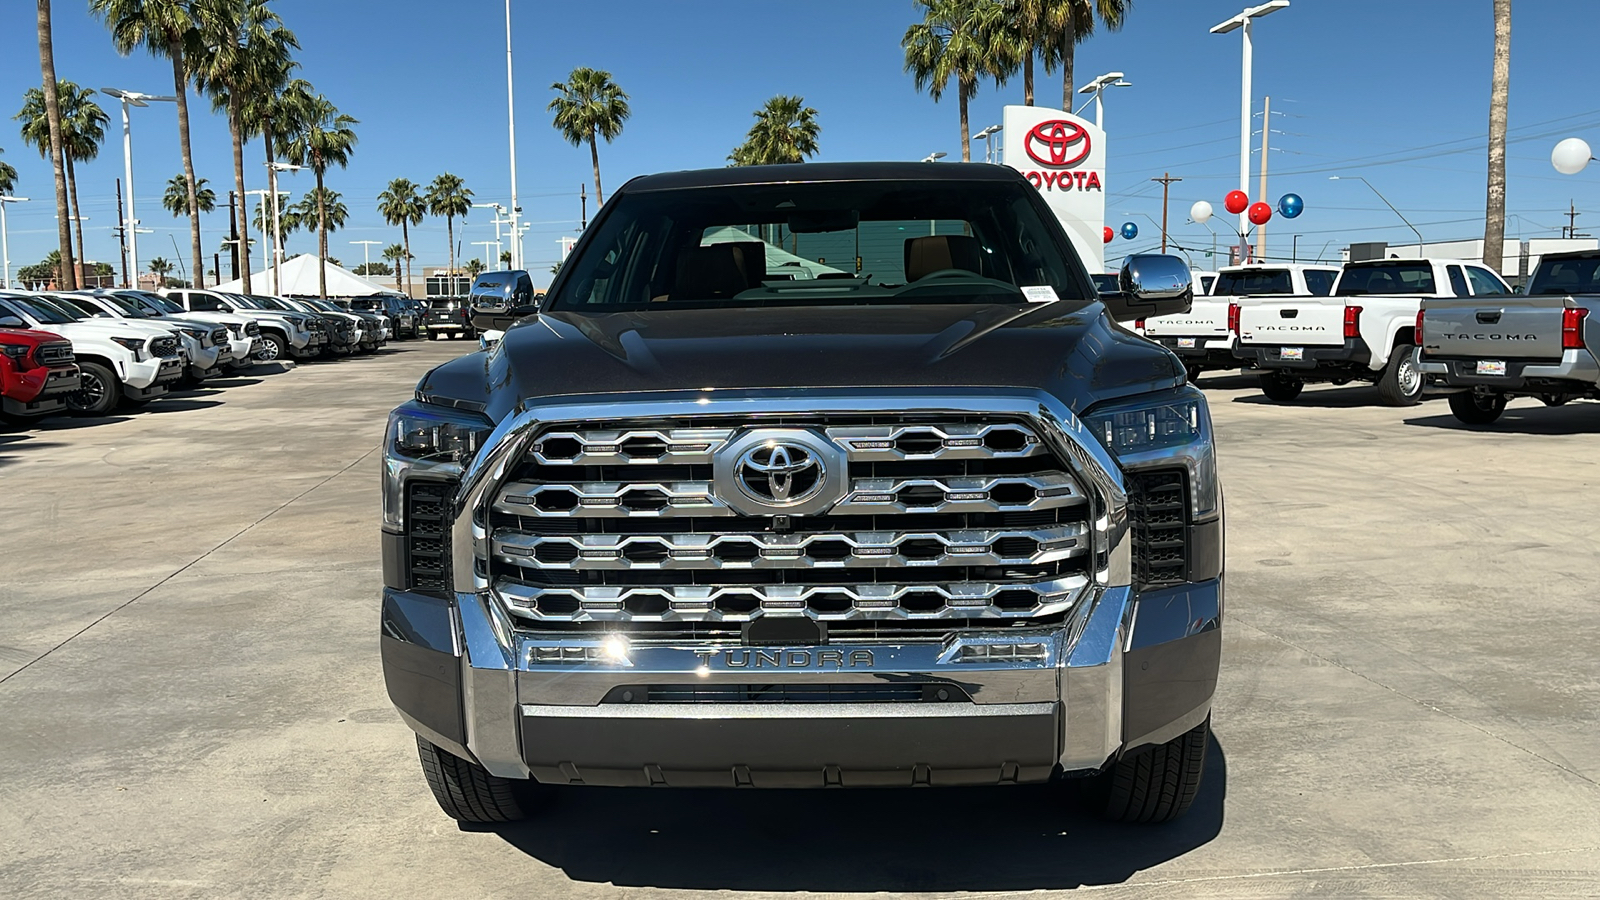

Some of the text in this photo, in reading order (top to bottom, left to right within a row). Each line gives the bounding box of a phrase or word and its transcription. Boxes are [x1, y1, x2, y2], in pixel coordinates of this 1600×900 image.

[1020, 171, 1102, 192] OYOTA
[1442, 333, 1538, 341] TACOMA
[694, 649, 875, 667] TUNDRA
